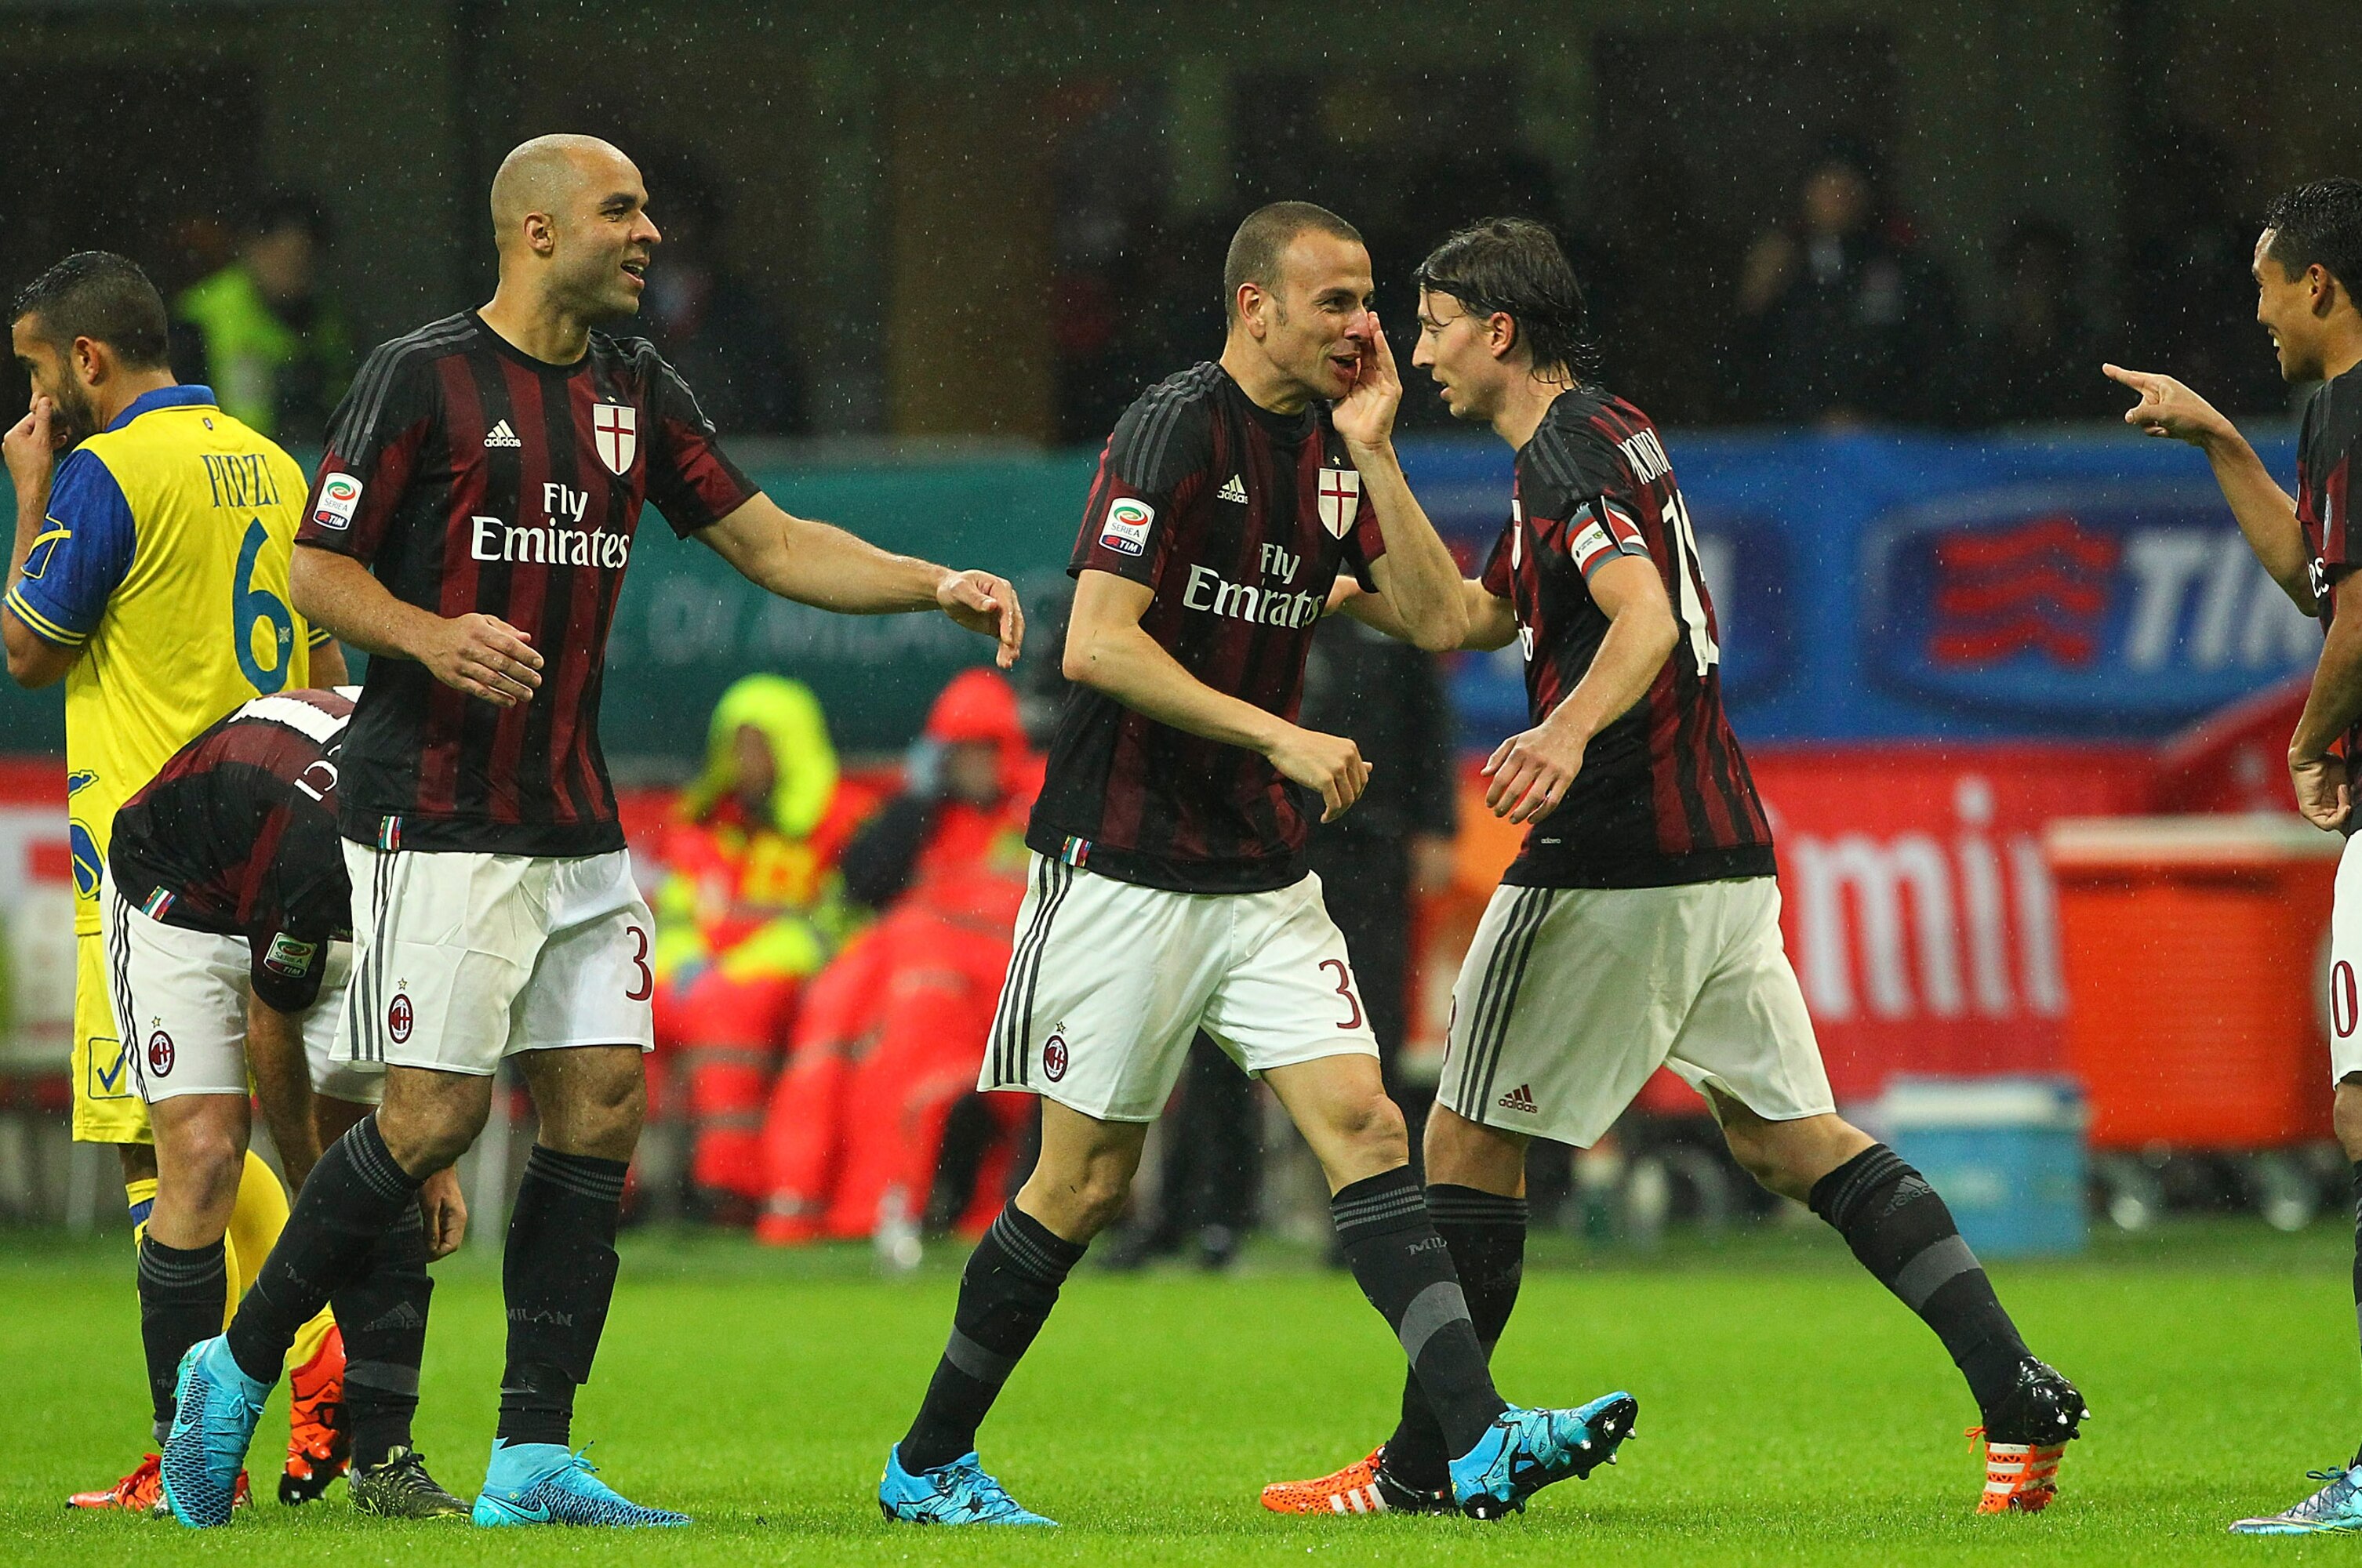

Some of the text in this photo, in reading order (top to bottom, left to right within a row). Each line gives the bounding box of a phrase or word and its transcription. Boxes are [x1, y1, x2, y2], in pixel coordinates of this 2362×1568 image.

[483, 436, 521, 448] adidas
[200, 453, 281, 508] PINZI
[324, 497, 343, 510] SERIE
[543, 482, 589, 522] Fly
[1216, 489, 1248, 505] adidas
[328, 514, 346, 528] TIM
[1110, 522, 1140, 538] SERIE A
[471, 515, 630, 568] Emirates
[1119, 539, 1139, 553] TIM
[1259, 543, 1301, 585] Fly
[1183, 563, 1325, 629] Emrats
[232, 517, 294, 695] 6
[283, 966, 302, 976] TIM
[625, 926, 652, 1001] 3
[2331, 960, 2359, 1038] 0
[1498, 1098, 1539, 1114] adidas
[505, 1308, 573, 1327] MILAN
